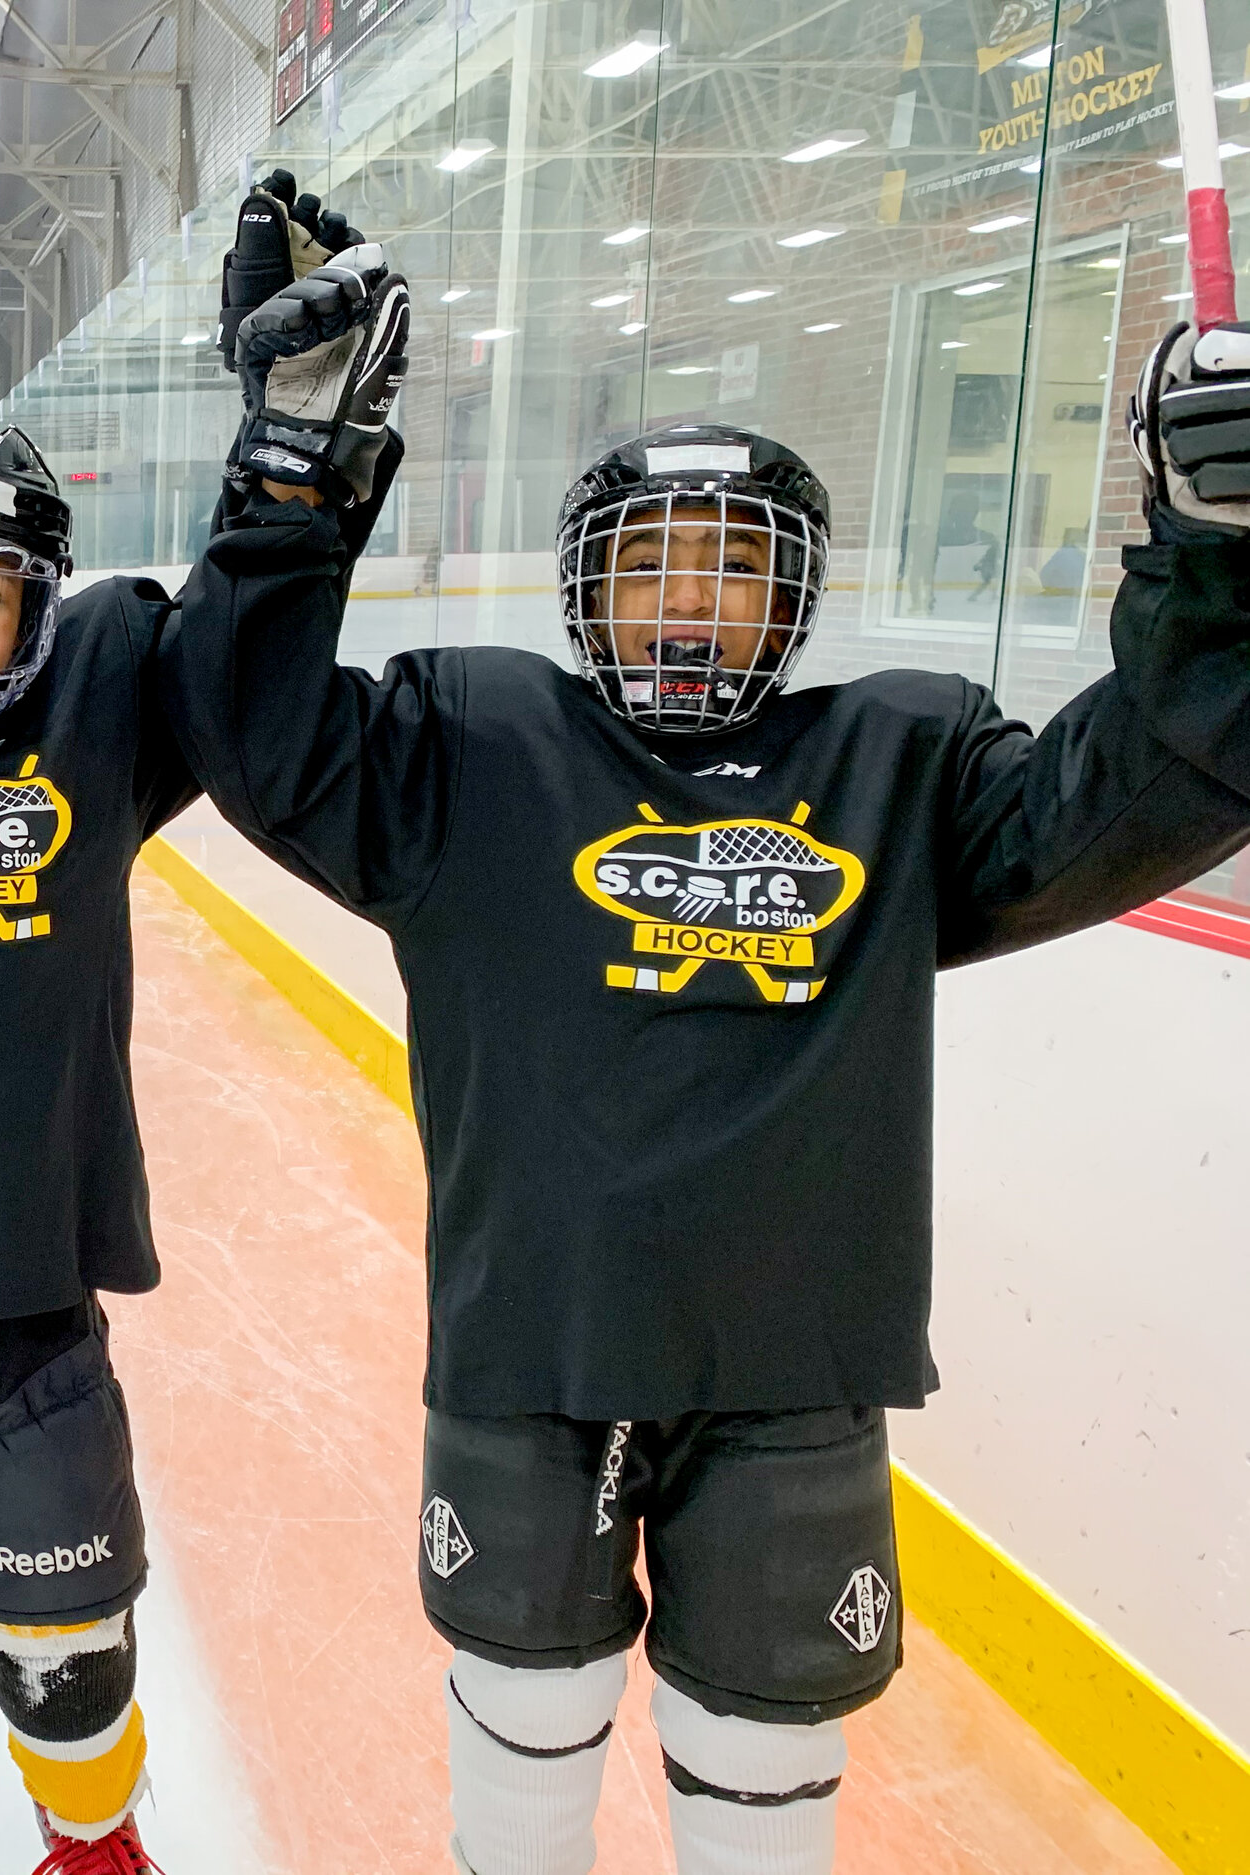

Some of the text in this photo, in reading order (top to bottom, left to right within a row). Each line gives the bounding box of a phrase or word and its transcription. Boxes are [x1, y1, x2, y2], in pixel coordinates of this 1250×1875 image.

[1011, 45, 1105, 109] MITON
[1051, 63, 1162, 129] HOCKEY
[972, 170, 983, 181] OF
[983, 164, 1002, 177] THE
[1074, 129, 1103, 149] LEARN
[1103, 125, 1114, 138] TO
[1114, 116, 1137, 133] PLAY
[1136, 100, 1175, 124] HOCKEY
[652, 927, 796, 962] HOCKEY
[737, 905, 817, 928] boston
[436, 1503, 447, 1571] TACKLA
[859, 1573, 873, 1644] TACKLA
